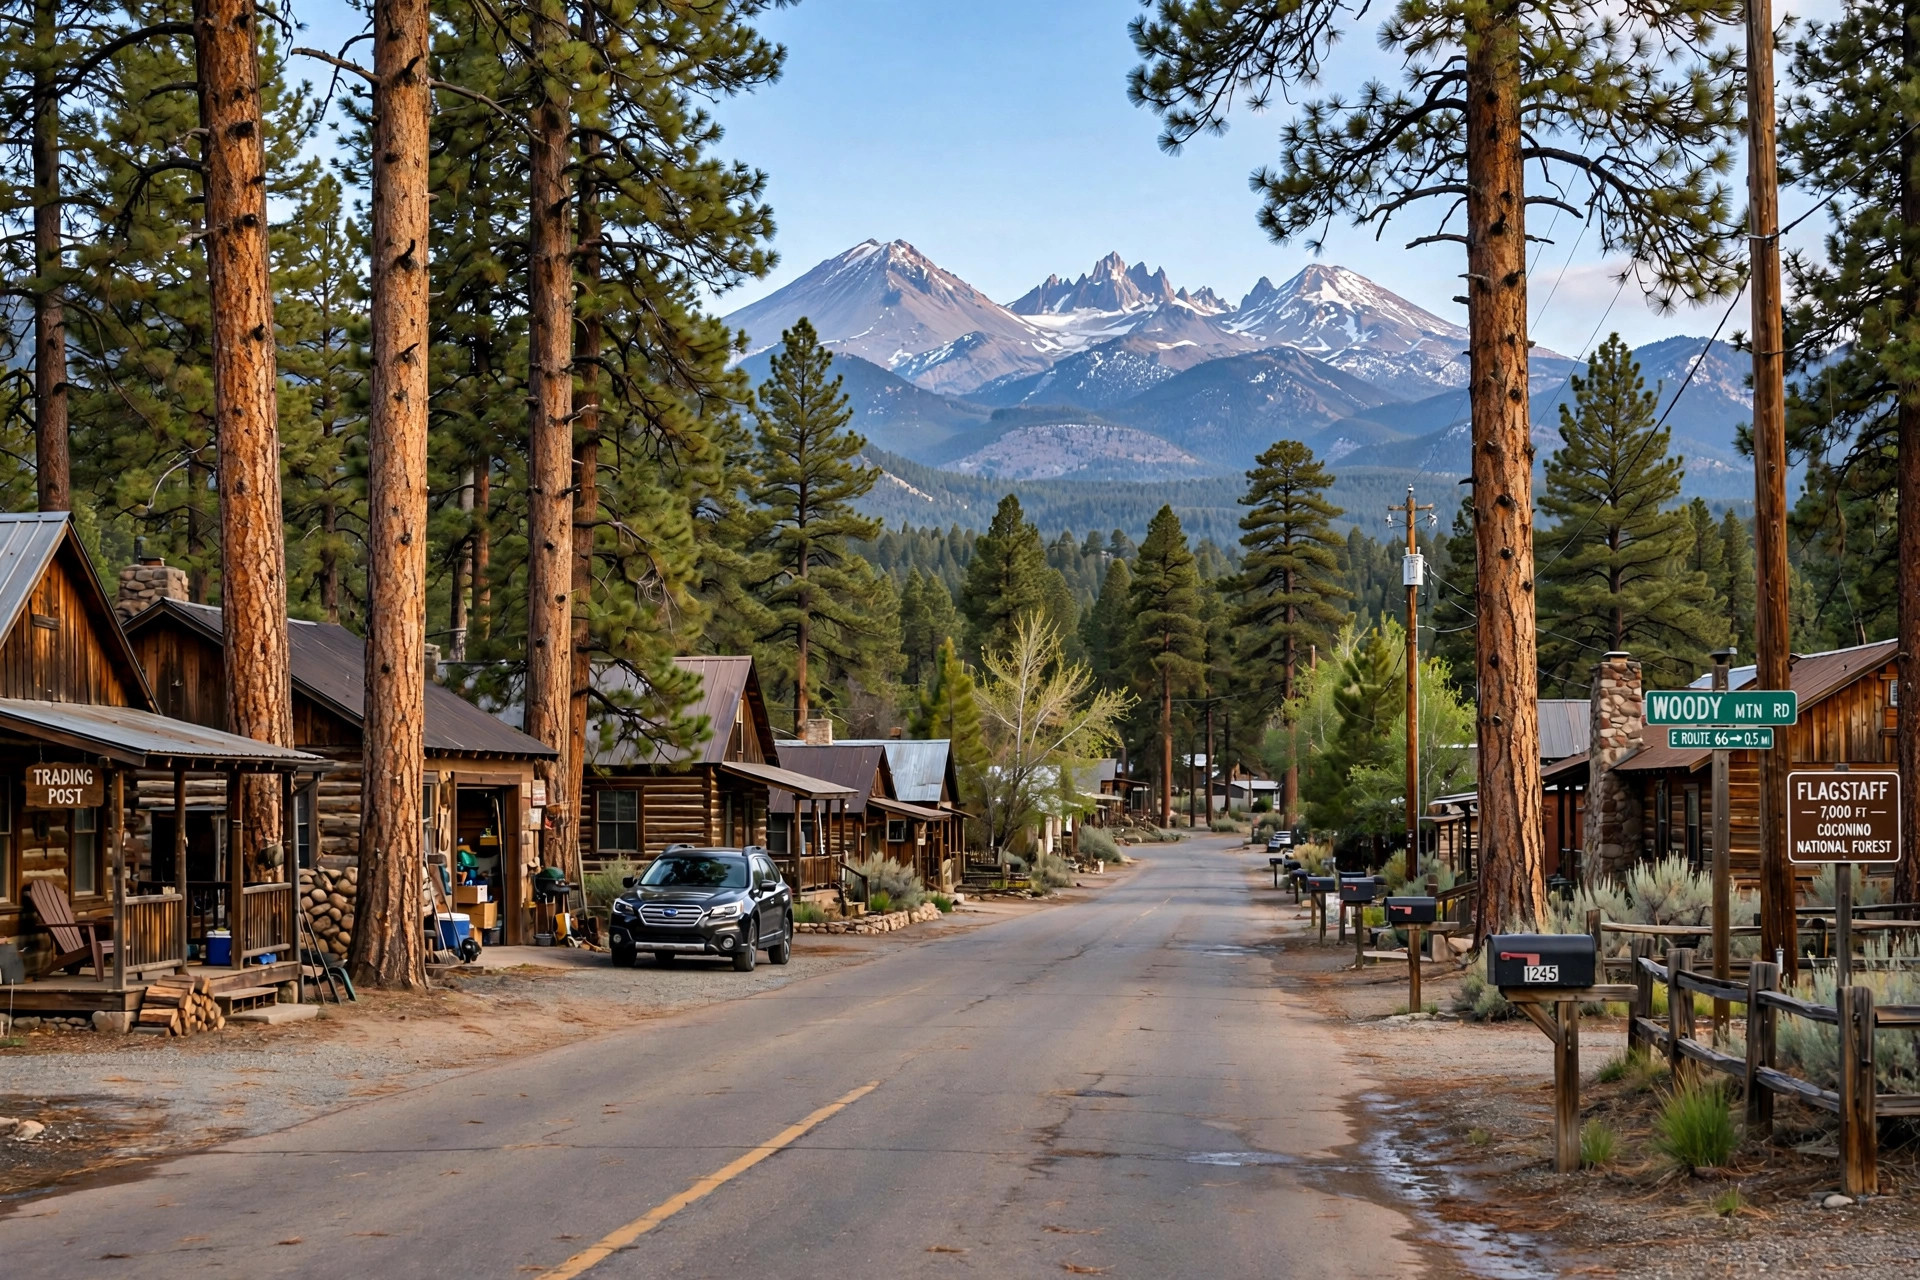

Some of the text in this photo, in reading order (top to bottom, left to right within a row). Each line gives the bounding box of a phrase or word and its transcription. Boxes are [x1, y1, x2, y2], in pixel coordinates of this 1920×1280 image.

[1652, 696, 1790, 720] WOODY MTN RD
[1671, 732, 1677, 745] E
[1681, 732, 1711, 745] ROUTE
[1714, 732, 1729, 746] 66
[1744, 732, 1759, 746] 0.5
[33, 768, 93, 786] TRADING
[48, 788, 83, 805] POST
[1797, 781, 1889, 801] FLAGSTAFF
[1820, 805, 1867, 821] 7,000 FT
[1817, 823, 1871, 837] COCONINO
[1797, 840, 1892, 853] NATIONAL FOREST
[1526, 966, 1557, 981] 1245
